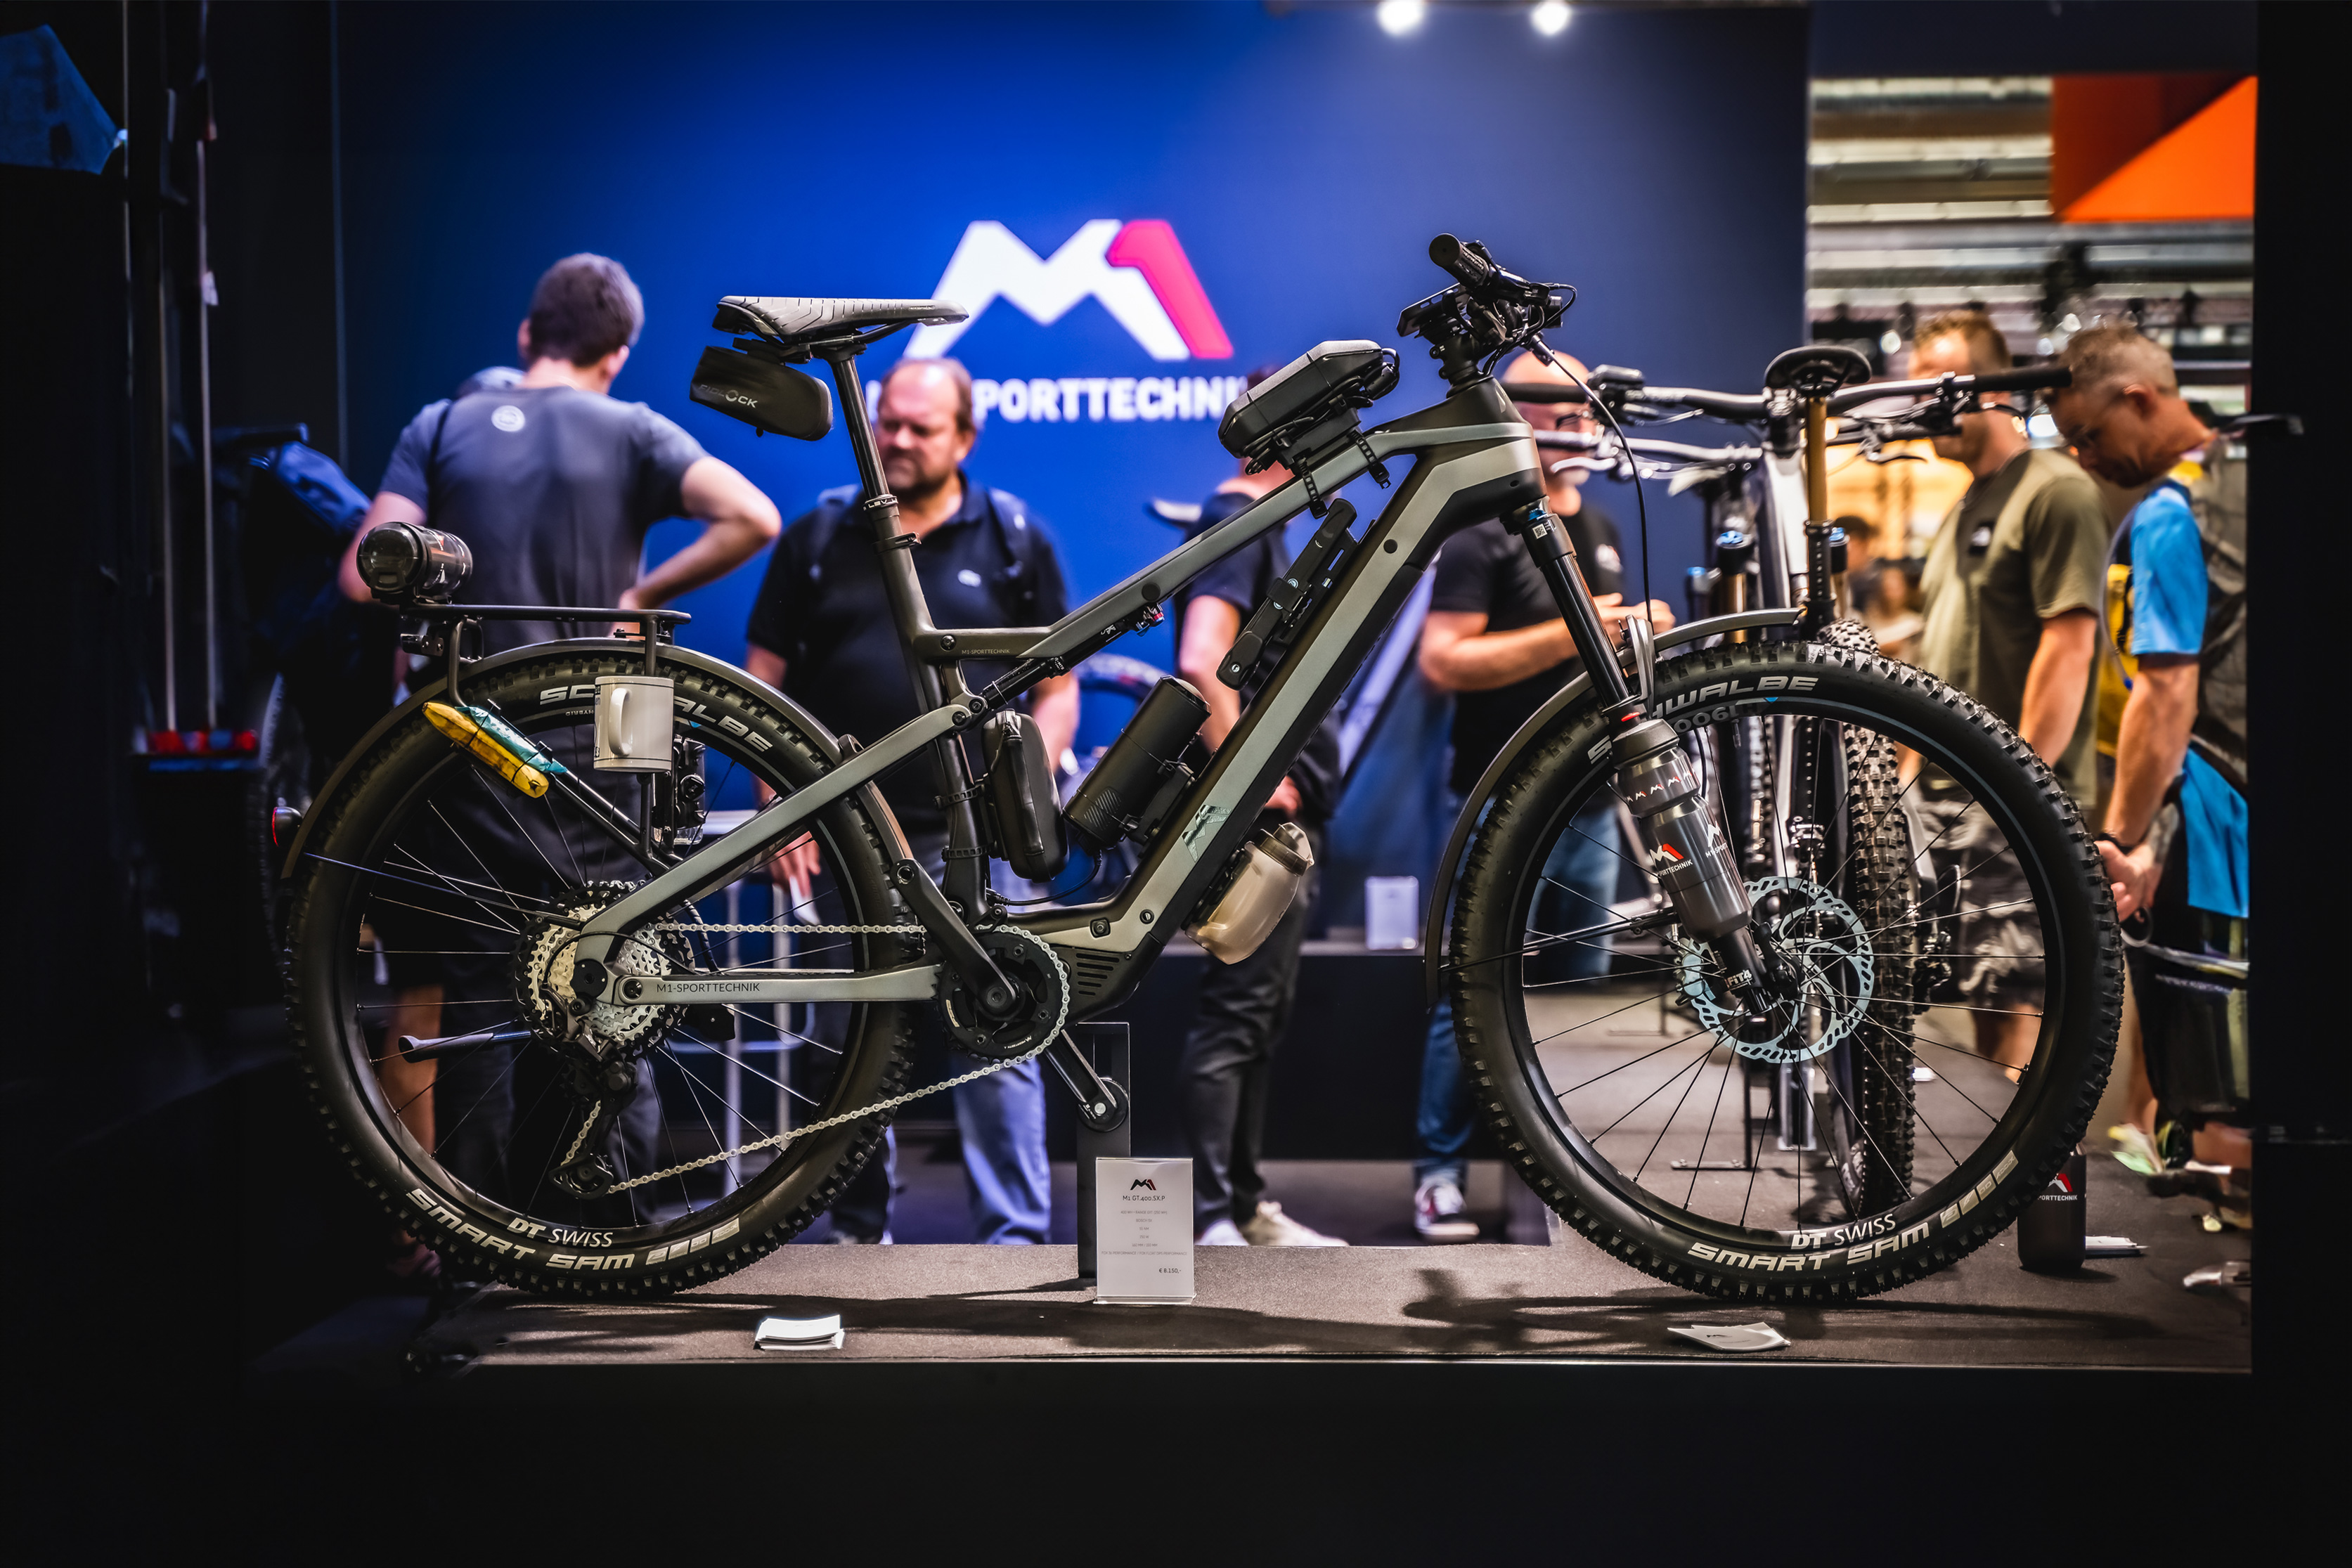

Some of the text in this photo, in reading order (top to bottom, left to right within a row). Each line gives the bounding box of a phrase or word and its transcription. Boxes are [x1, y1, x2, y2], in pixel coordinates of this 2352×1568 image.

[698, 384, 758, 409] FIDLOCK
[540, 684, 773, 752] SCALBE
[1587, 676, 1819, 764] SWALBE
[657, 983, 760, 993] M1-SPORTTECHNIK
[406, 1188, 635, 1270] SMART SAM
[506, 1217, 613, 1248] DT SWISS
[1687, 1222, 1929, 1272] SMART SAM
[1790, 1213, 1897, 1252] DT SWISS
